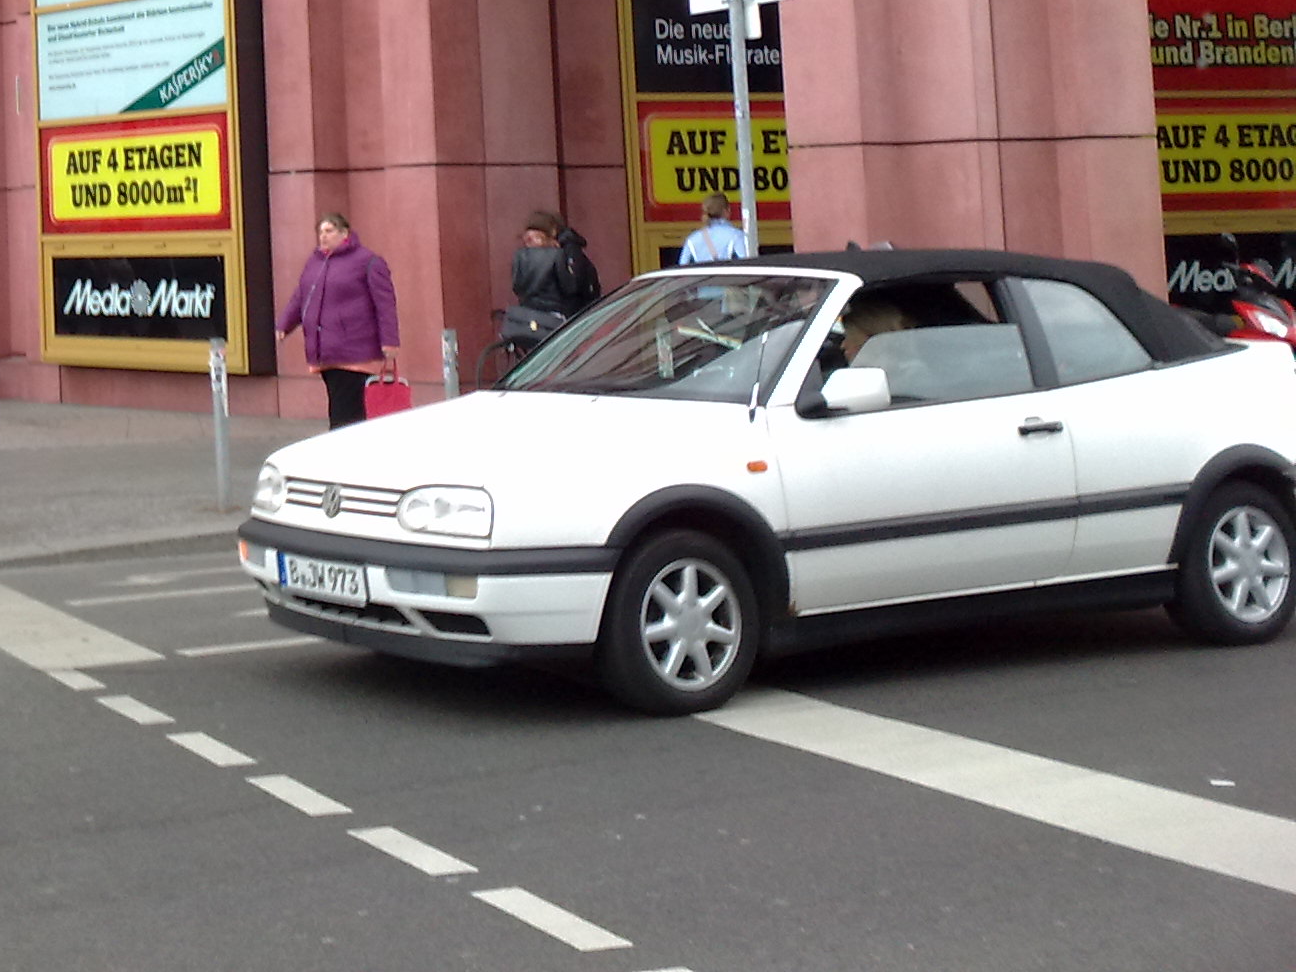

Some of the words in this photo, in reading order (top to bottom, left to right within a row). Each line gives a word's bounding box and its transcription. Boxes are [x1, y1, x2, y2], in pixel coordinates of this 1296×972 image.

[655, 18, 684, 40] Die
[1226, 13, 1249, 39] in
[656, 43, 780, 65] Musik-Flrate
[1151, 40, 1194, 65] und
[1199, 39, 1296, 65] Branden
[158, 51, 214, 105] KASPERSKY
[667, 130, 727, 155] AUF
[1156, 125, 1207, 149] AUF
[1215, 124, 1230, 148] 4
[66, 149, 103, 175] AUF
[107, 147, 119, 173] 4
[123, 142, 202, 172] ETAGEN
[1161, 159, 1221, 184] UND
[674, 166, 741, 192] UND
[71, 183, 112, 208] UND
[63, 278, 132, 316] Media
[146, 278, 216, 318] Markt
[328, 565, 359, 595] 973
